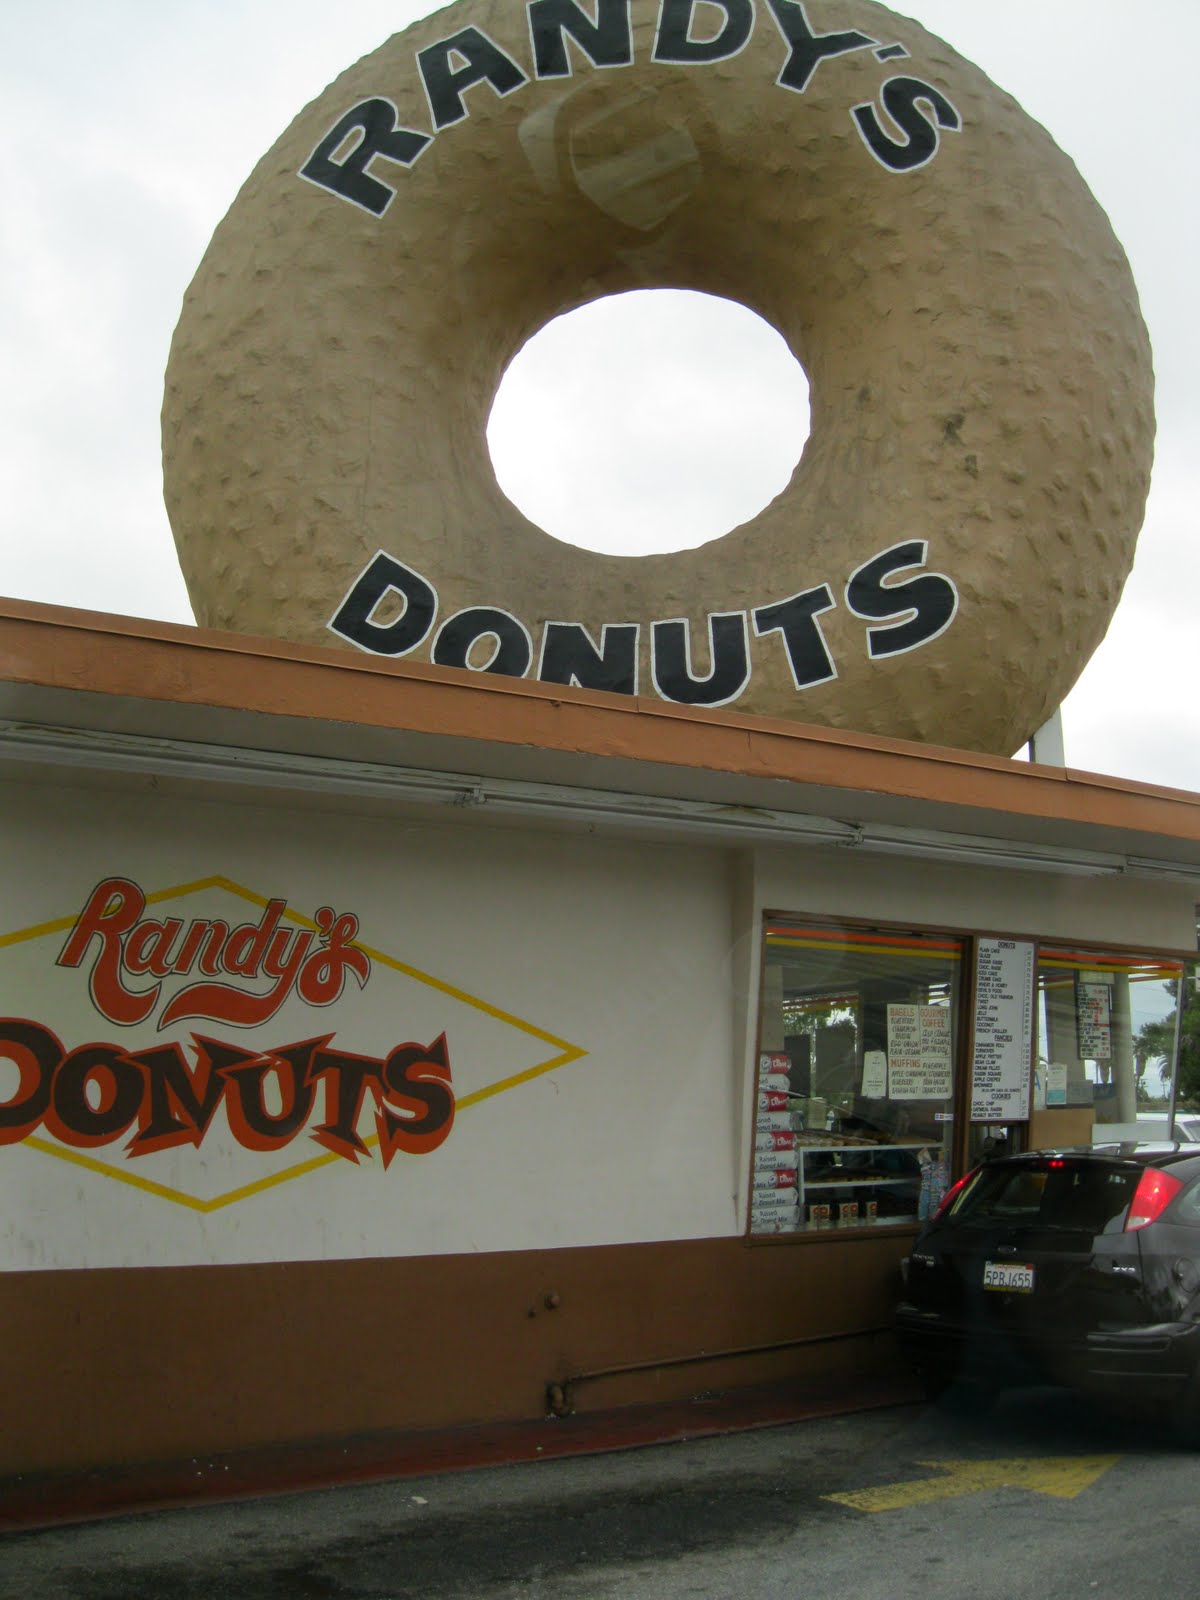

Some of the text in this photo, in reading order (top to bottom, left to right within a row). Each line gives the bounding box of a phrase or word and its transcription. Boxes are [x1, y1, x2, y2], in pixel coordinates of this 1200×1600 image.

[298, 0, 961, 218] RANDY'S
[327, 539, 959, 708] DONUTS
[56, 877, 371, 1031] Randy's
[889, 1008, 915, 1017] BAGELS
[920, 1008, 949, 1018] GOURMET
[922, 1020, 945, 1028] COFFEE
[890, 1059, 921, 1068] MUFFINS
[985, 1270, 1031, 1288] 5PBJ655
